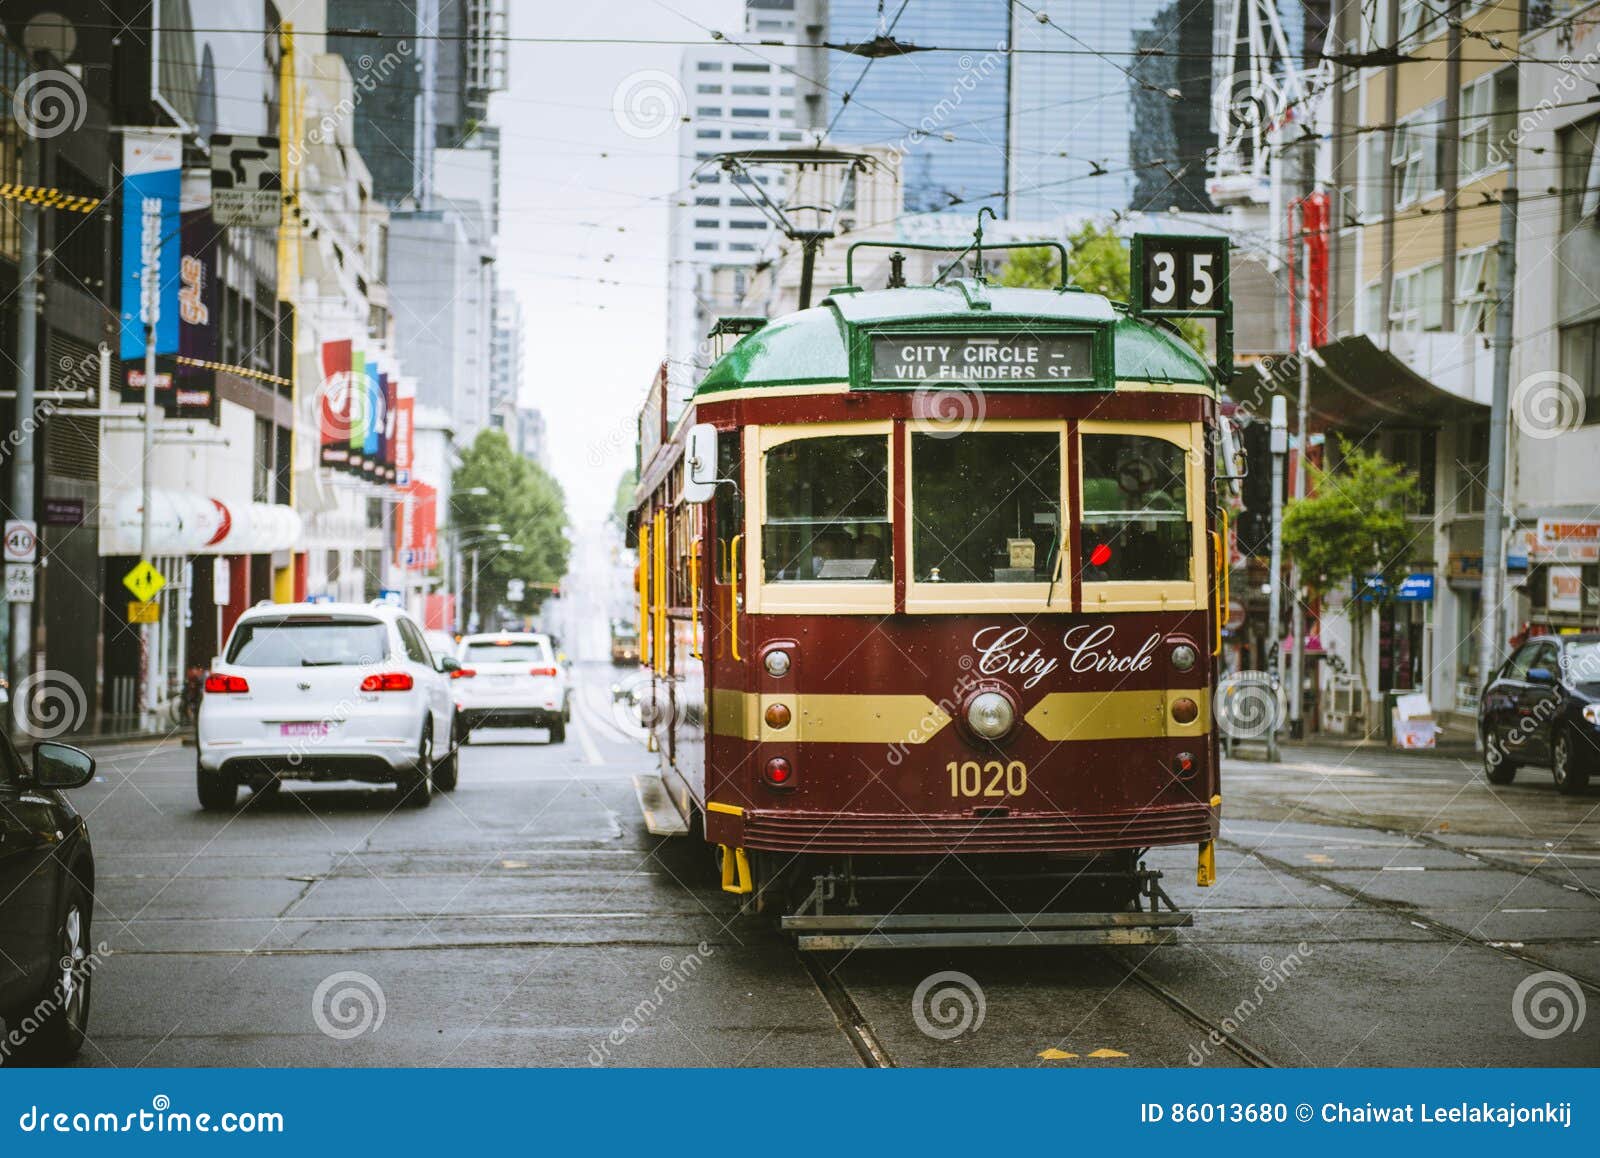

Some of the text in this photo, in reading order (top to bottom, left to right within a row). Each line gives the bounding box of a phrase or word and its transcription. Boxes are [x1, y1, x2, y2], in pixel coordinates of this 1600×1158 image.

[1151, 252, 1214, 305] 35
[902, 346, 950, 362] CITY
[963, 346, 1039, 362] CIRCLE
[895, 365, 1072, 379] VIA FLINDERS ST
[10, 535, 32, 549] 40
[972, 624, 1161, 690] City Circle
[946, 761, 1028, 797] 1020
